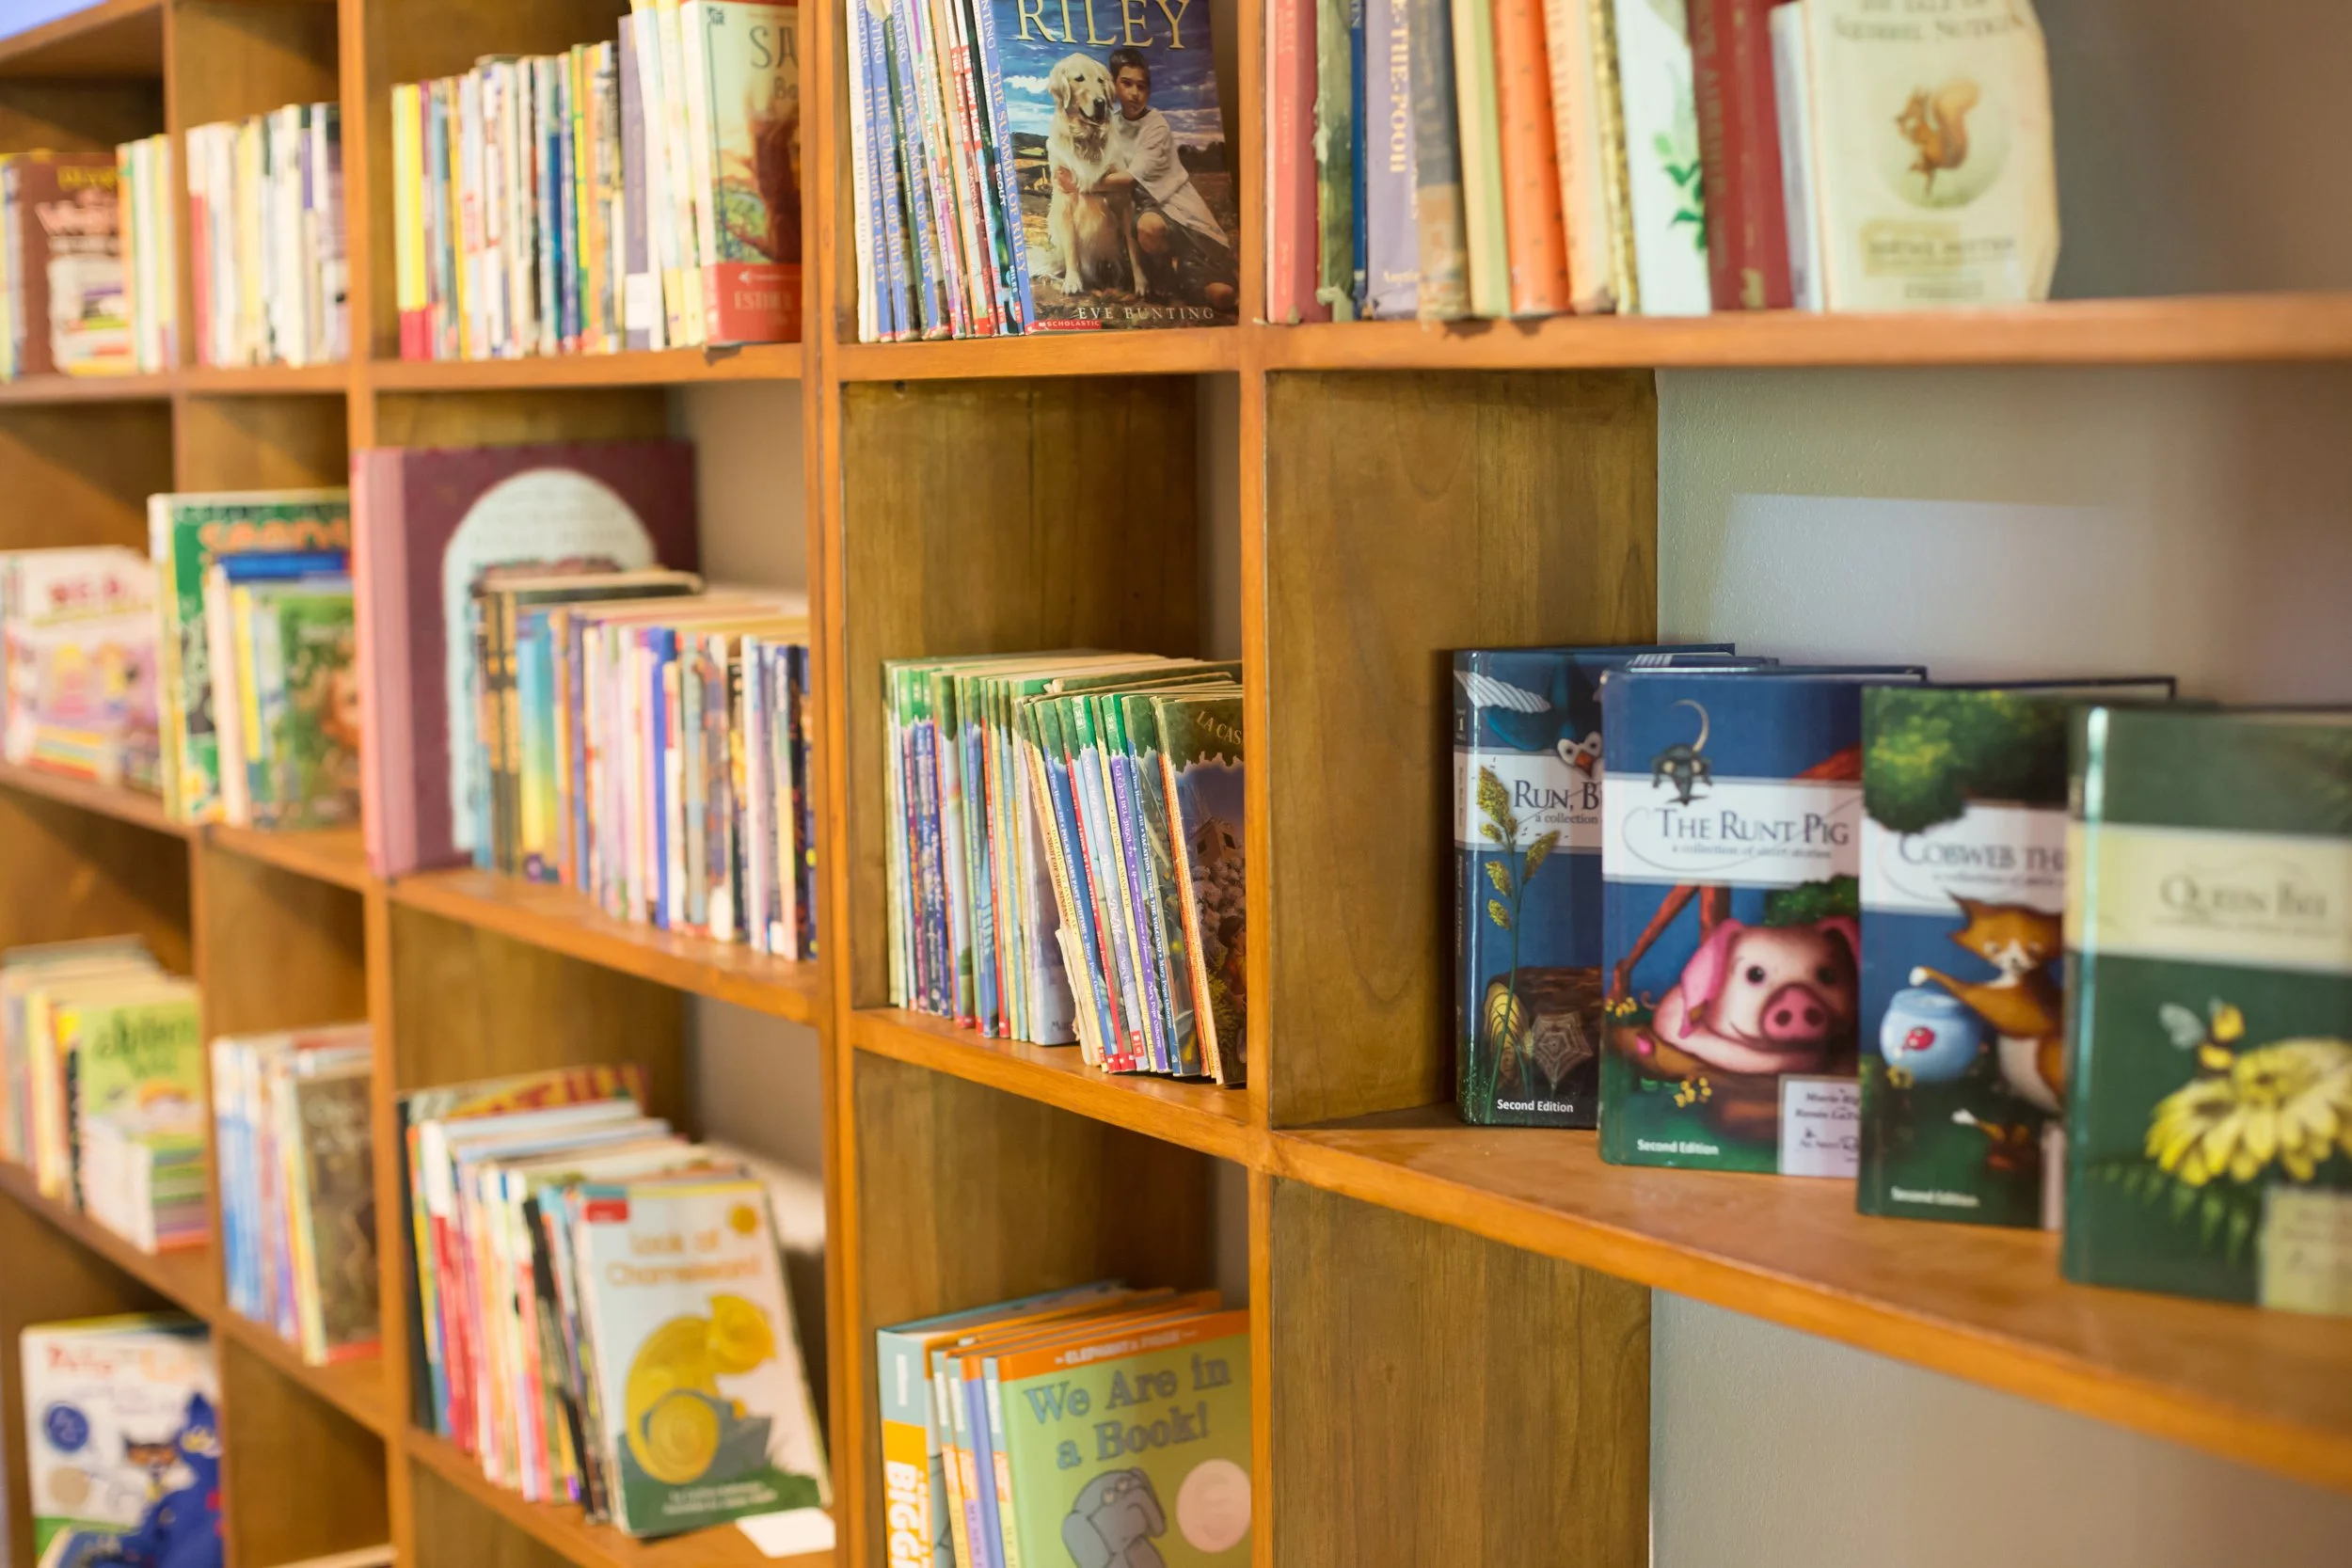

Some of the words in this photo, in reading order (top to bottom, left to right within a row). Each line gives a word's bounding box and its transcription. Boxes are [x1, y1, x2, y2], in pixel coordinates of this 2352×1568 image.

[868, 15, 884, 64] NTING
[977, 0, 998, 49] NTING
[1018, 0, 1191, 49] RILEY
[949, 53, 960, 71] THE
[960, 49, 970, 68] THE
[876, 85, 888, 119] THE
[900, 83, 913, 118] THE
[952, 75, 965, 106] PUPPY
[963, 72, 976, 104] PUPPY
[990, 67, 1005, 106] THE
[958, 111, 971, 141] PLACE
[969, 108, 982, 141] PLACE
[879, 124, 895, 198] SUMMER
[905, 121, 923, 197] SUMMER
[995, 110, 1017, 187] SUMMER
[965, 166, 982, 225] PATCHES
[993, 163, 1007, 206] SCOUT
[866, 127, 879, 200] SUMMER
[874, 233, 885, 282] RILEY
[885, 204, 897, 228] OF
[914, 201, 926, 224] OF
[1007, 192, 1019, 214] OF
[888, 231, 902, 283] RILEY
[917, 229, 932, 278] RILEY
[1010, 221, 1027, 272] RILEY
[1008, 264, 1018, 292] MILES
[1078, 307, 1114, 320] EVE
[1125, 307, 1215, 320] BUNTING
[1196, 710, 1213, 733] LA
[1216, 722, 1243, 746] CAS
[1045, 754, 1054, 771] Magic
[1049, 773, 1057, 788] Tree
[1514, 780, 1573, 812] RUN,
[1581, 781, 1602, 811] B
[1053, 789, 1061, 810] House
[1110, 816, 1120, 853] DELFINES
[1535, 813, 1541, 822] a
[1544, 812, 1598, 824] collection
[1654, 807, 1713, 841] THE
[1720, 809, 1797, 843] RUNT
[1803, 813, 1851, 846] PIG
[1060, 829, 1070, 853] POLAR
[1899, 832, 2017, 869] COBWEB
[1046, 837, 1056, 860] NIGHT
[1058, 891, 1069, 916] NINJAS
[1051, 829, 1064, 870] DOLPHINS
[1063, 885, 1077, 929] DAYBREAK
[1066, 854, 1075, 878] BEARS
[1071, 879, 1079, 897] PAST
[1084, 864, 1096, 910] LUNCHTIME
[1128, 754, 1136, 773] Magic
[1134, 790, 1142, 810] House
[1140, 833, 1151, 870] VACATION
[1146, 872, 1154, 897] UNDER
[1152, 916, 1162, 952] VOLCANO
[1164, 999, 1173, 1028] Osborne
[1075, 899, 1087, 933] BEDTIME
[1116, 776, 1126, 799] CASA
[1147, 980, 1155, 999] Mary
[1153, 1019, 1162, 1048] Osborne
[1084, 942, 1092, 960] Mary
[1088, 961, 1096, 979] Pope
[1092, 980, 1103, 1008] Osborne
[1497, 1099, 1534, 1111] Second
[1537, 1101, 1574, 1113] Edition
[1637, 1138, 1677, 1153] Second
[1679, 1140, 1720, 1155] Edition
[1024, 1380, 1091, 1426] We
[1105, 1369, 1179, 1411] Are
[1190, 1351, 1234, 1392] in
[1057, 1438, 1083, 1471] a
[1092, 1399, 1211, 1463] Book!
